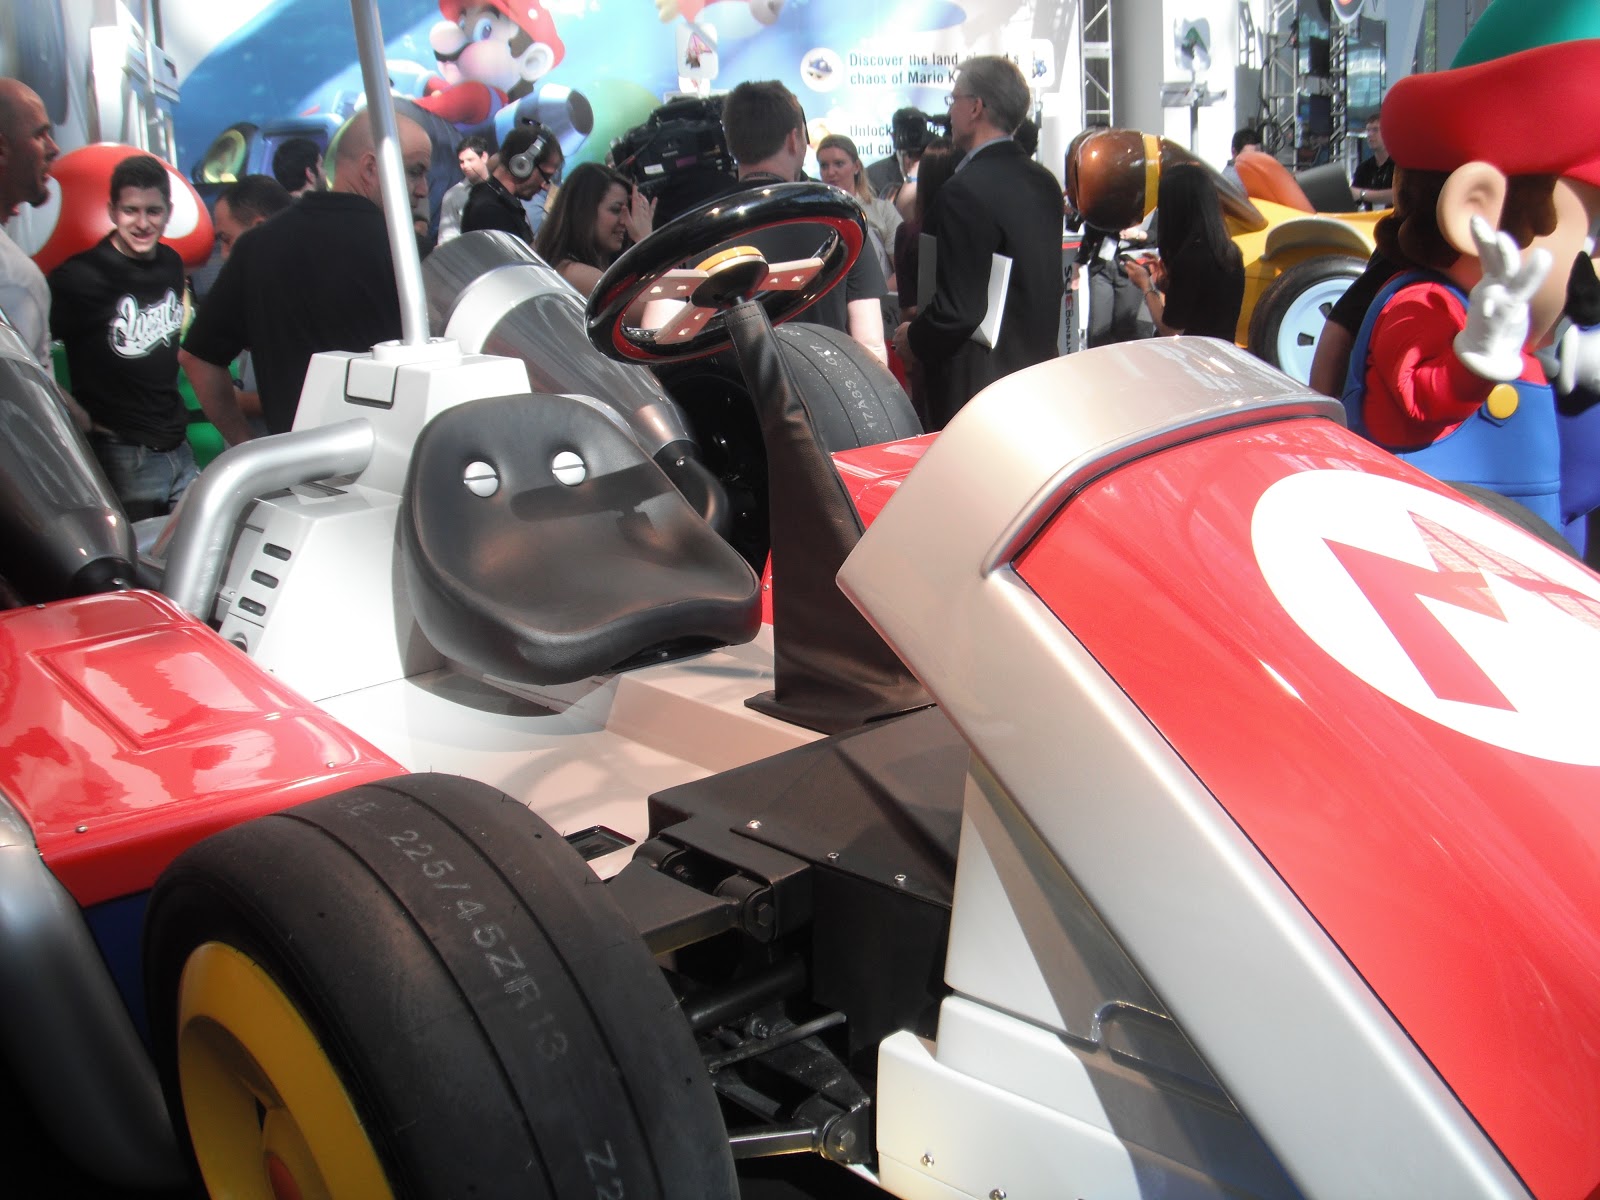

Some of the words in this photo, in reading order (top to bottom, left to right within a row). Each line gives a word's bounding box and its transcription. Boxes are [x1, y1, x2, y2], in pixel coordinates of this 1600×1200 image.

[849, 53, 903, 66] Discover
[909, 53, 928, 66] the
[850, 72, 887, 85] chaos
[891, 71, 903, 85] of
[908, 71, 944, 84] Mario
[849, 123, 892, 136] Unlock
[857, 143, 873, 155] nd
[1321, 510, 1600, 712] M
